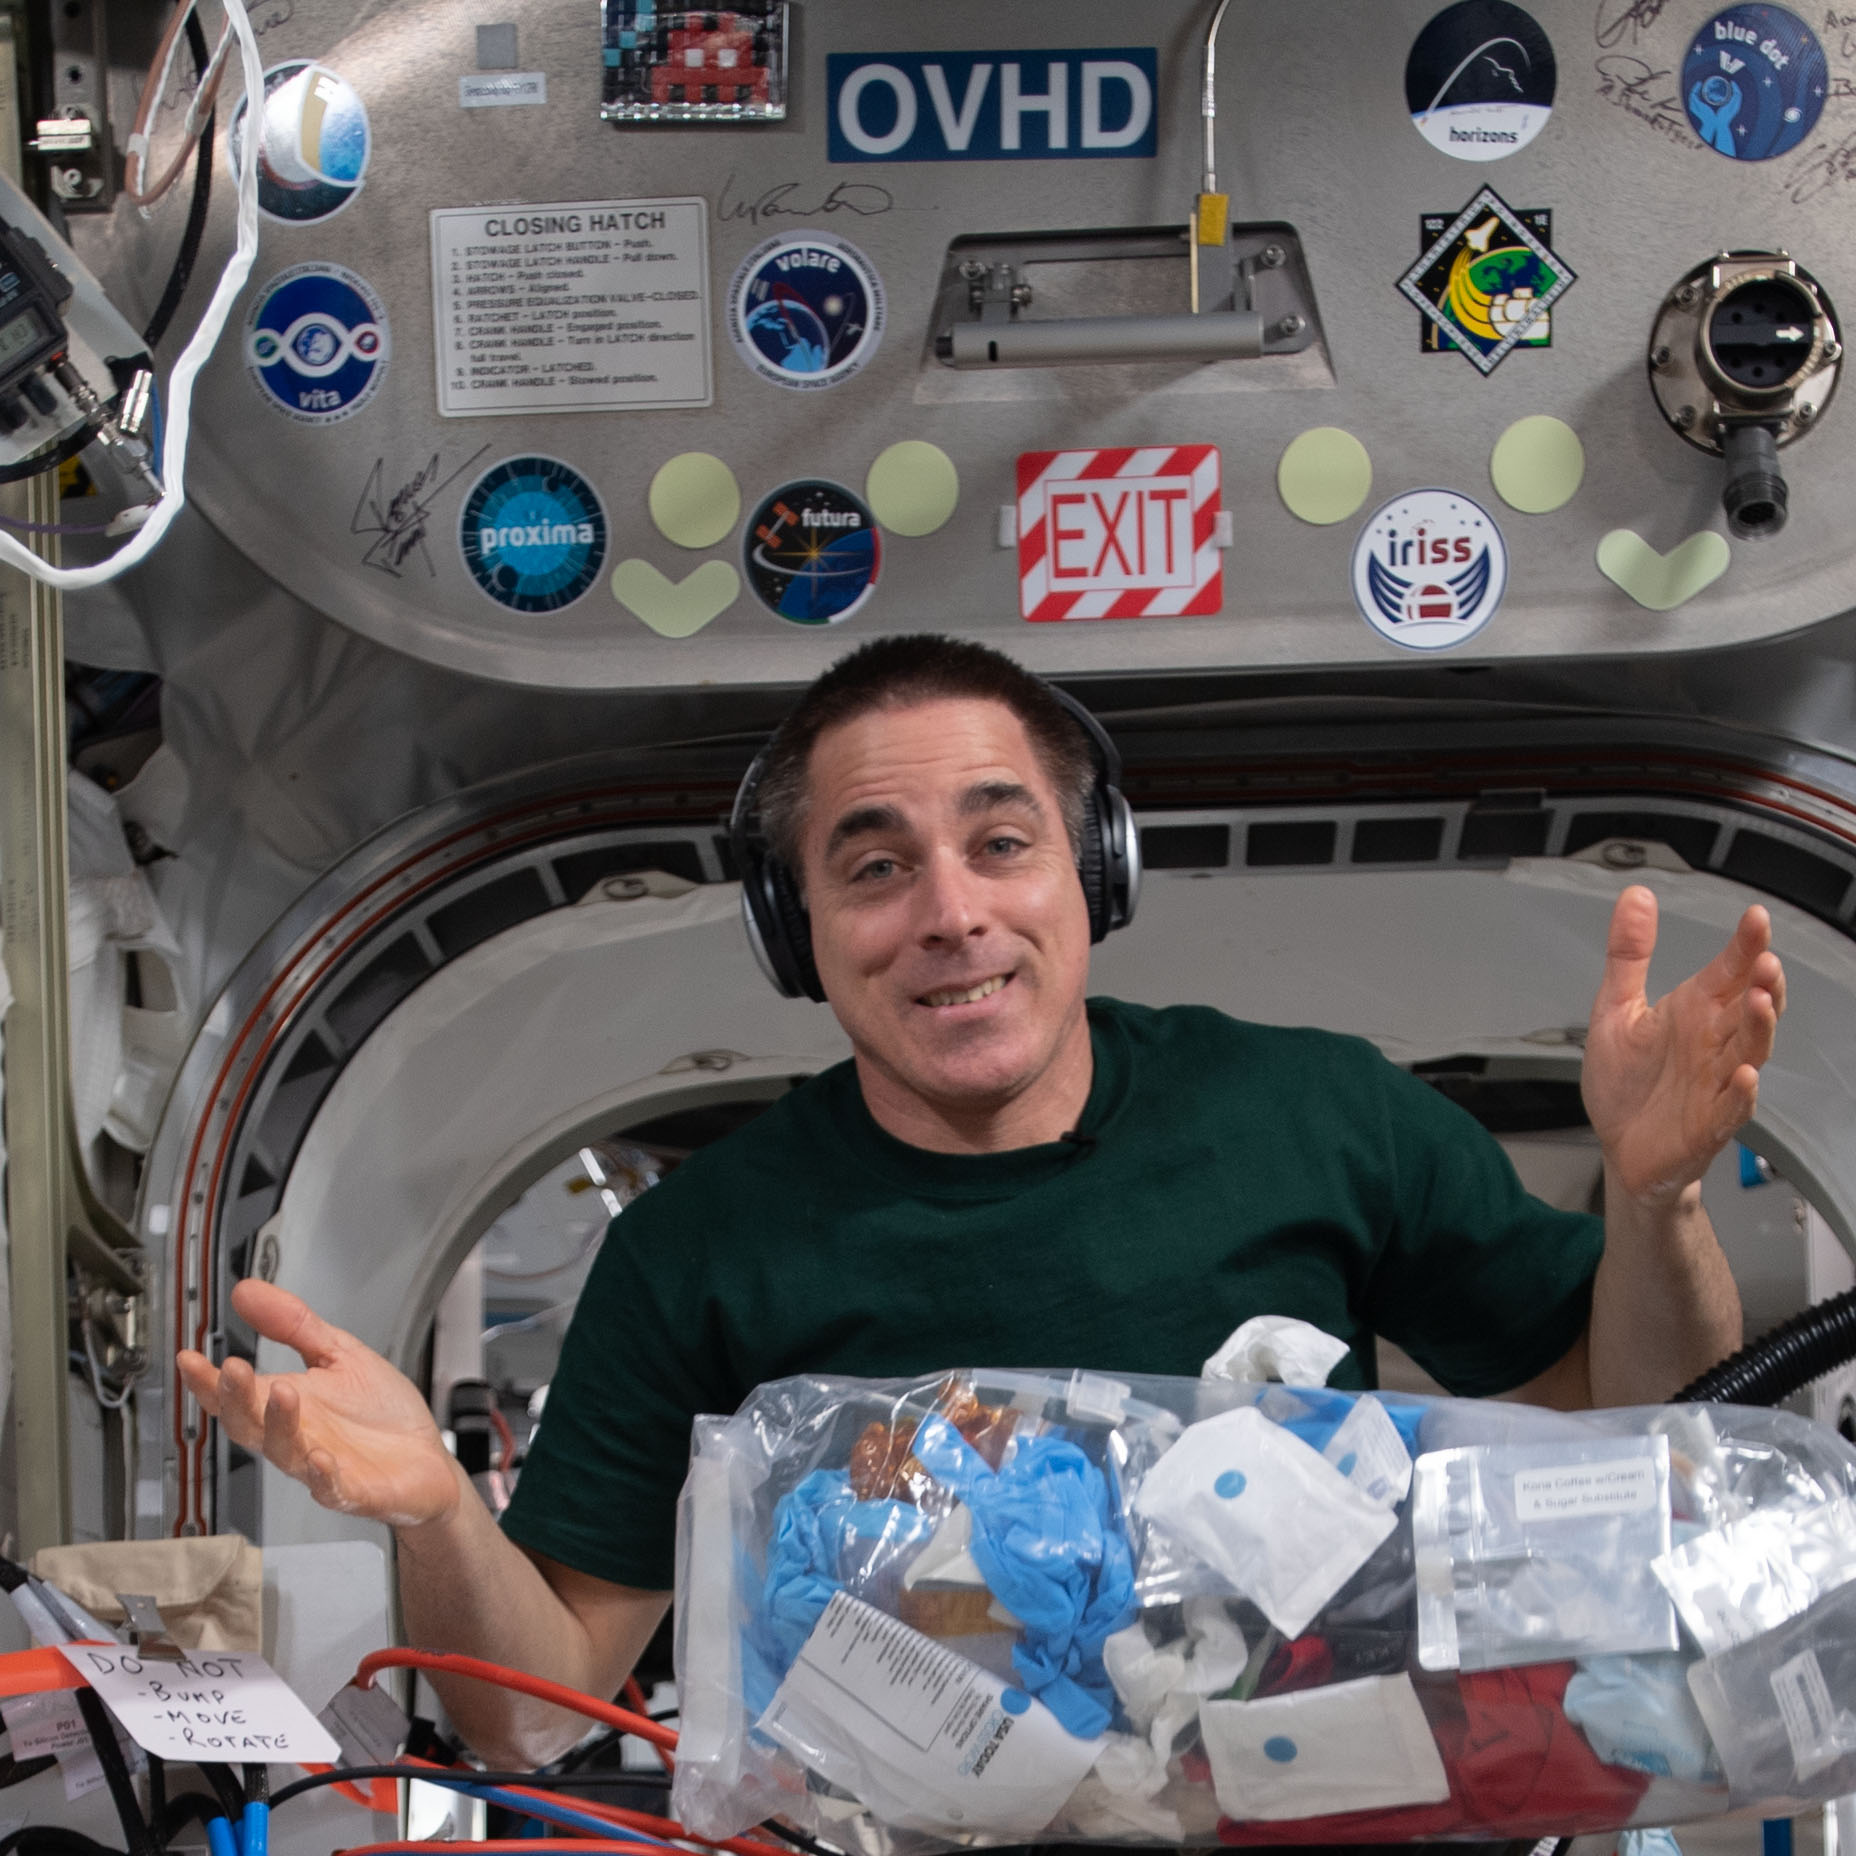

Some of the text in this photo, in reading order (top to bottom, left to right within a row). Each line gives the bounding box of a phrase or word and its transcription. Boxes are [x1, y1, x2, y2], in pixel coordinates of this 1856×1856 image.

[1713, 20, 1789, 71] blue dot
[837, 60, 1153, 155] OVHD
[1449, 125, 1521, 146] horizons
[485, 212, 666, 237] CLOSING HATCH
[466, 240, 653, 256] STOWAGE LATCH BUTTON Push.
[466, 258, 522, 270] STOWAGE
[525, 257, 562, 268] LATCH
[566, 254, 610, 266] HANDLE
[623, 253, 642, 262] Pull
[776, 248, 841, 273] volare
[466, 272, 505, 283] HATCH
[516, 270, 542, 281] Push
[467, 282, 570, 296] ARROWS Aligned.
[467, 294, 608, 310] PRESSURE EQUALIZATION
[468, 308, 618, 323] RATCHET LATCH position.
[468, 320, 664, 336] CRANK HANDLE Engaged position.
[468, 332, 694, 350] CRANK HANDLE Turn LATCH direction
[470, 362, 597, 376] INDICATOR LATCHED.
[471, 373, 658, 390] CRANK HANDLE Stowed position.
[298, 388, 342, 410] vita
[801, 506, 862, 530] futura
[480, 518, 595, 555] proxima
[1050, 489, 1188, 579] EXIT
[1386, 528, 1474, 568] iriss
[1522, 1468, 1646, 1493] Kona Coffee w/Cream
[1545, 1494, 1579, 1512] Sugar
[1581, 1488, 1638, 1506] Substitute
[86, 1652, 244, 1681] DO NOT
[56, 1719, 77, 1732] P01
[51, 1738, 75, 1750] Power
[972, 1715, 1014, 1779] USA TODAY
